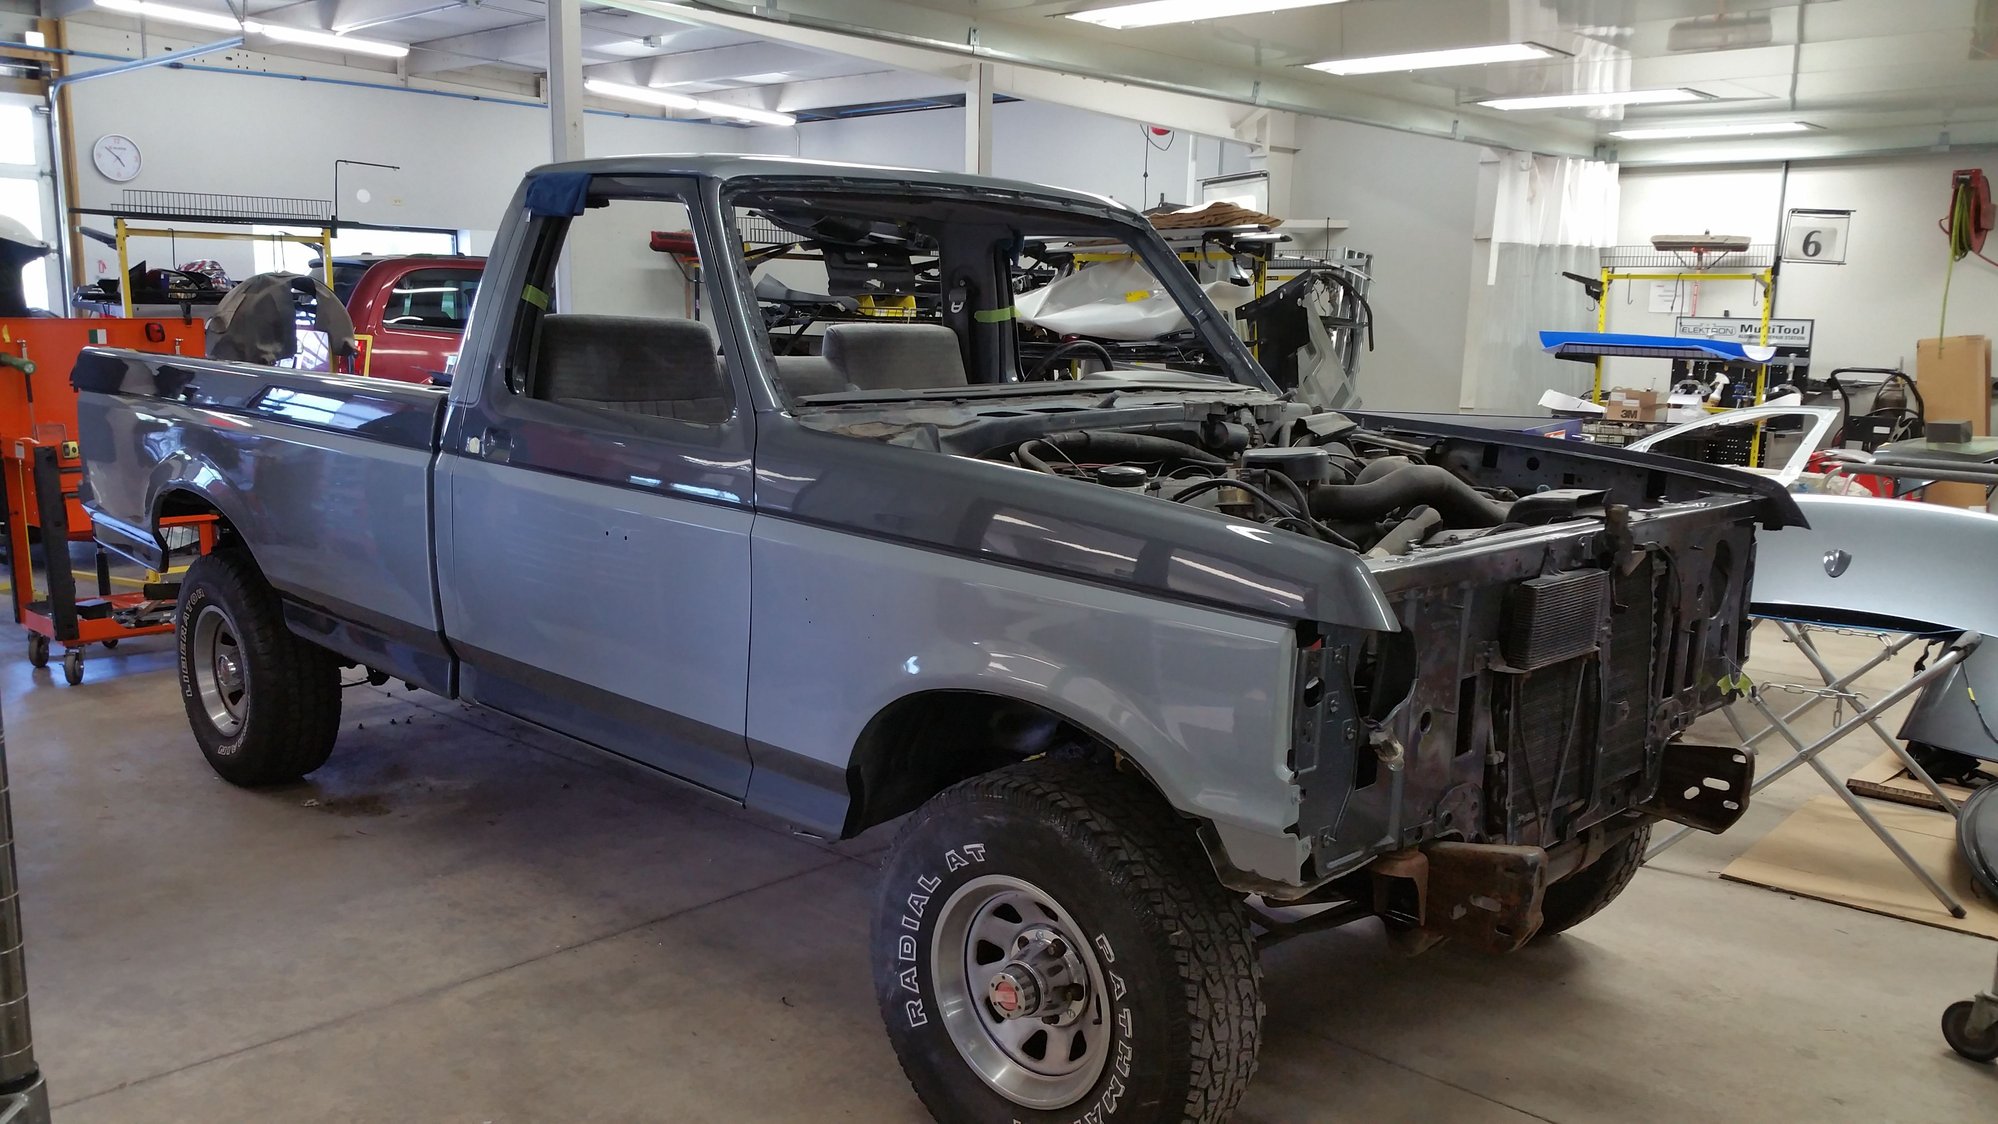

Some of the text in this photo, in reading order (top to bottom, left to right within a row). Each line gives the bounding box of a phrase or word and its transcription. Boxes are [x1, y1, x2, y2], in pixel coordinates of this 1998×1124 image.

[1802, 230, 1822, 257] 6
[1681, 326, 1734, 335] ELEKTRON
[1740, 323, 1805, 335] MutiTool
[1620, 409, 1638, 419] 3M
[898, 842, 987, 1028] RADIAL AT
[1074, 932, 1134, 1124] PATHMA
